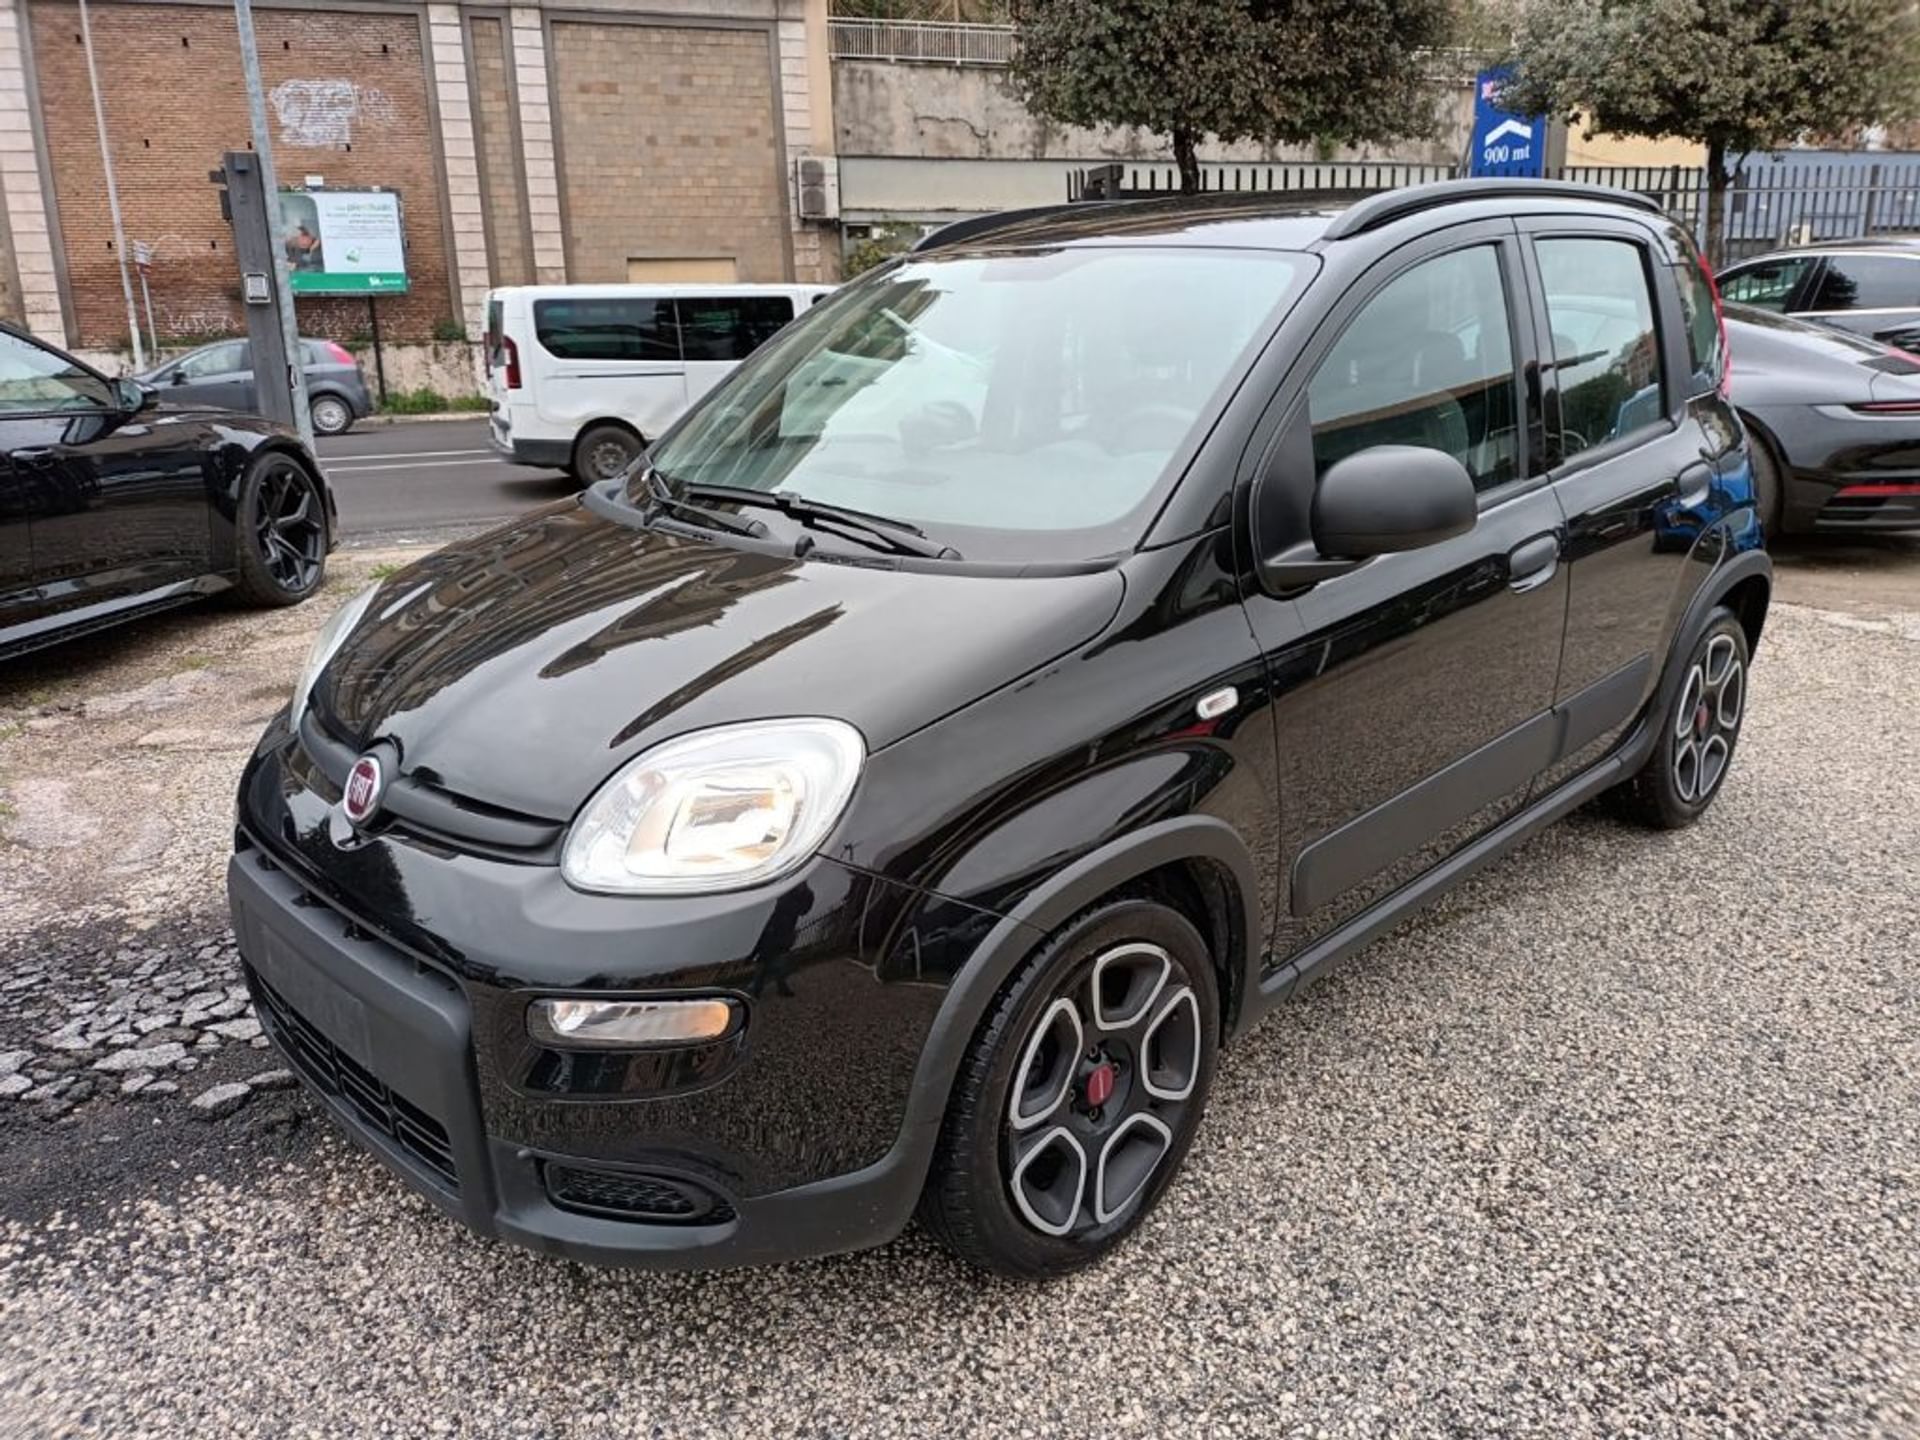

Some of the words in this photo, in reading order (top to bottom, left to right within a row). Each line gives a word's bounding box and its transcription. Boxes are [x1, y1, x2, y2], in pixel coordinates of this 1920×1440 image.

[1484, 145, 1509, 166] 900
[1512, 144, 1530, 161] mt
[350, 773, 373, 806] FIAT
